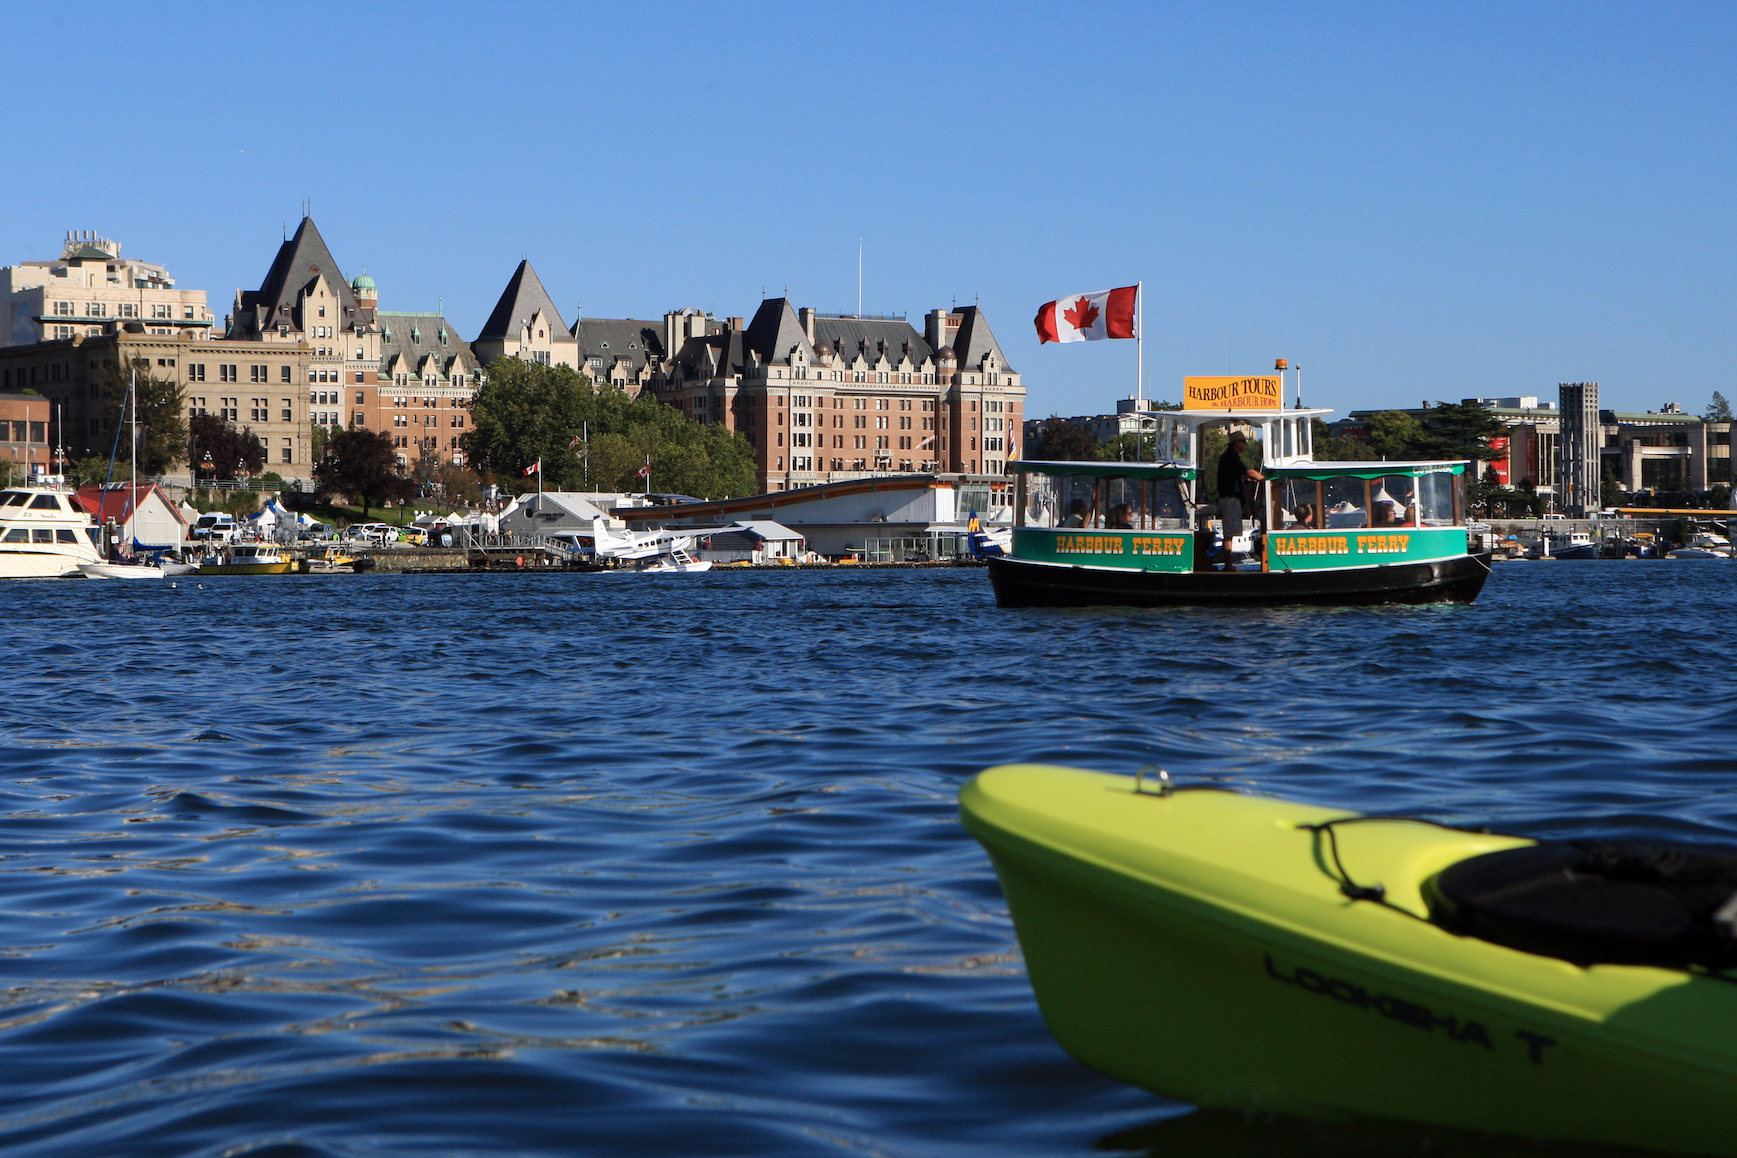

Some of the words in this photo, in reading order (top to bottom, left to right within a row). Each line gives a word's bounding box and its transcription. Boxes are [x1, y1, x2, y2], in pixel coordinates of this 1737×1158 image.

[1188, 381, 1239, 401] HARBOUR
[1241, 378, 1277, 397] TOURS
[1220, 396, 1259, 407] HARBOUR
[1056, 536, 1124, 555] HARBOUR
[1132, 537, 1186, 556] FERRY
[1275, 536, 1349, 556] HARBOUR
[1356, 535, 1410, 554] FERRY
[1515, 1029, 1557, 1063] T
